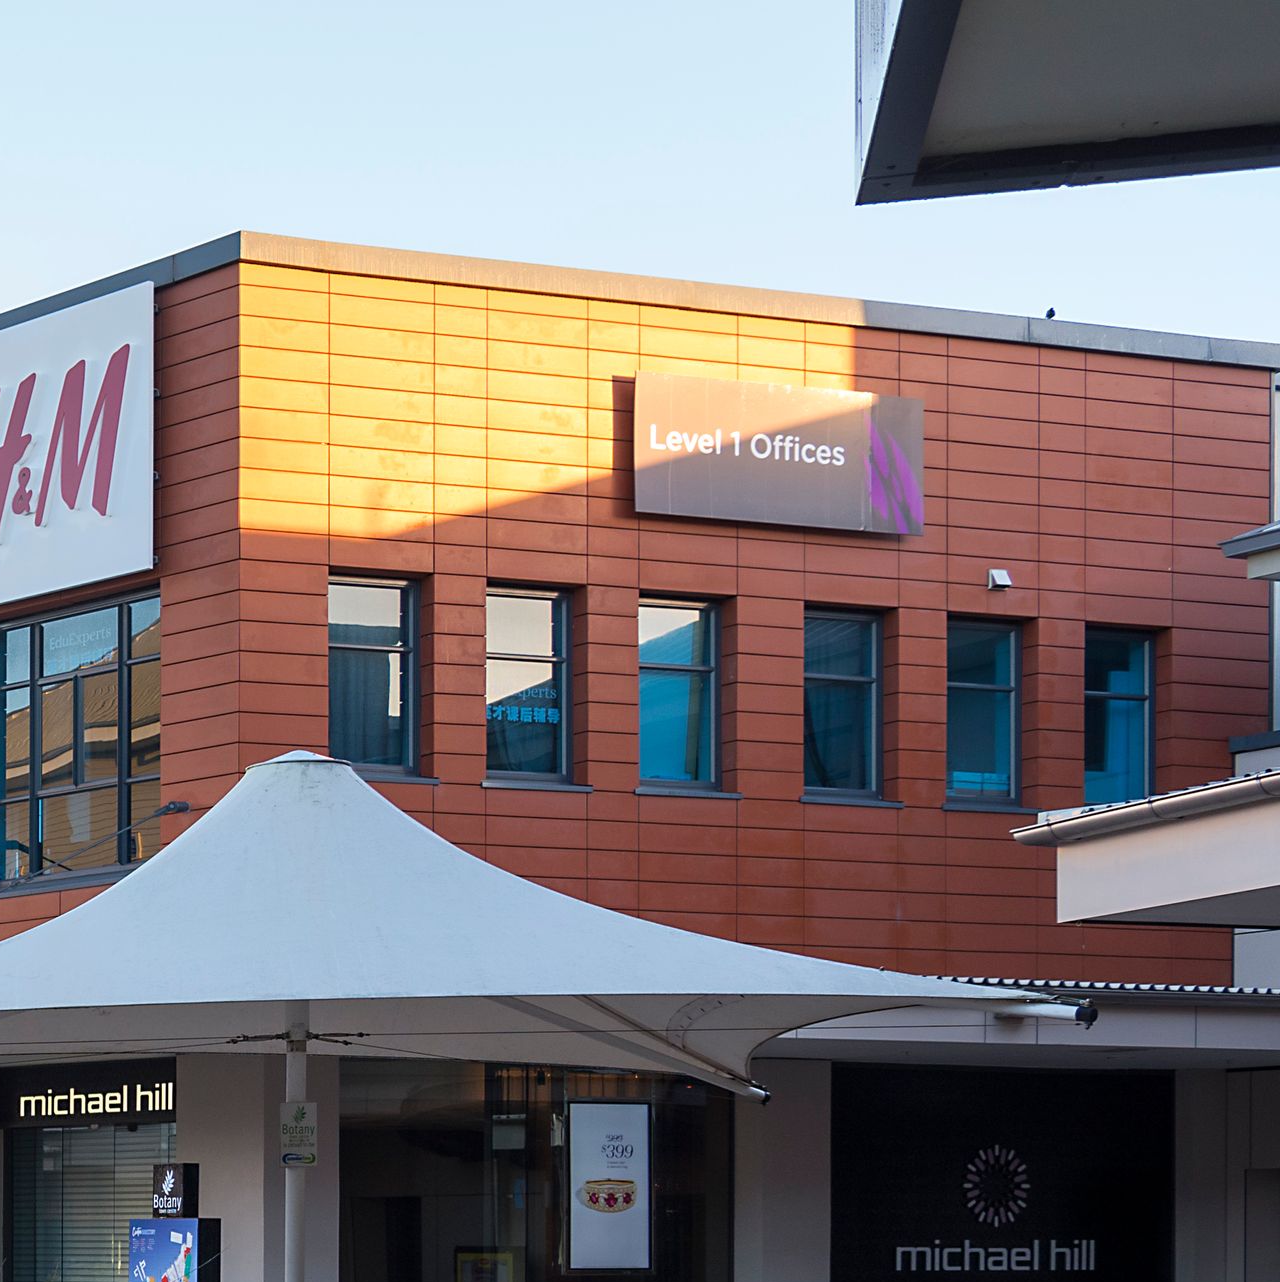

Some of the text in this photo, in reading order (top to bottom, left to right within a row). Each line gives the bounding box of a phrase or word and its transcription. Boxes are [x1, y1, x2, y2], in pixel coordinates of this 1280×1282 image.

[649, 423, 845, 466] Level 1 Offices
[20, 1082, 173, 1117] michael hill
[282, 1124, 315, 1136] Botany
[601, 1144, 634, 1159] $399
[153, 1194, 182, 1211] Botany
[896, 1239, 1095, 1271] michael hill
